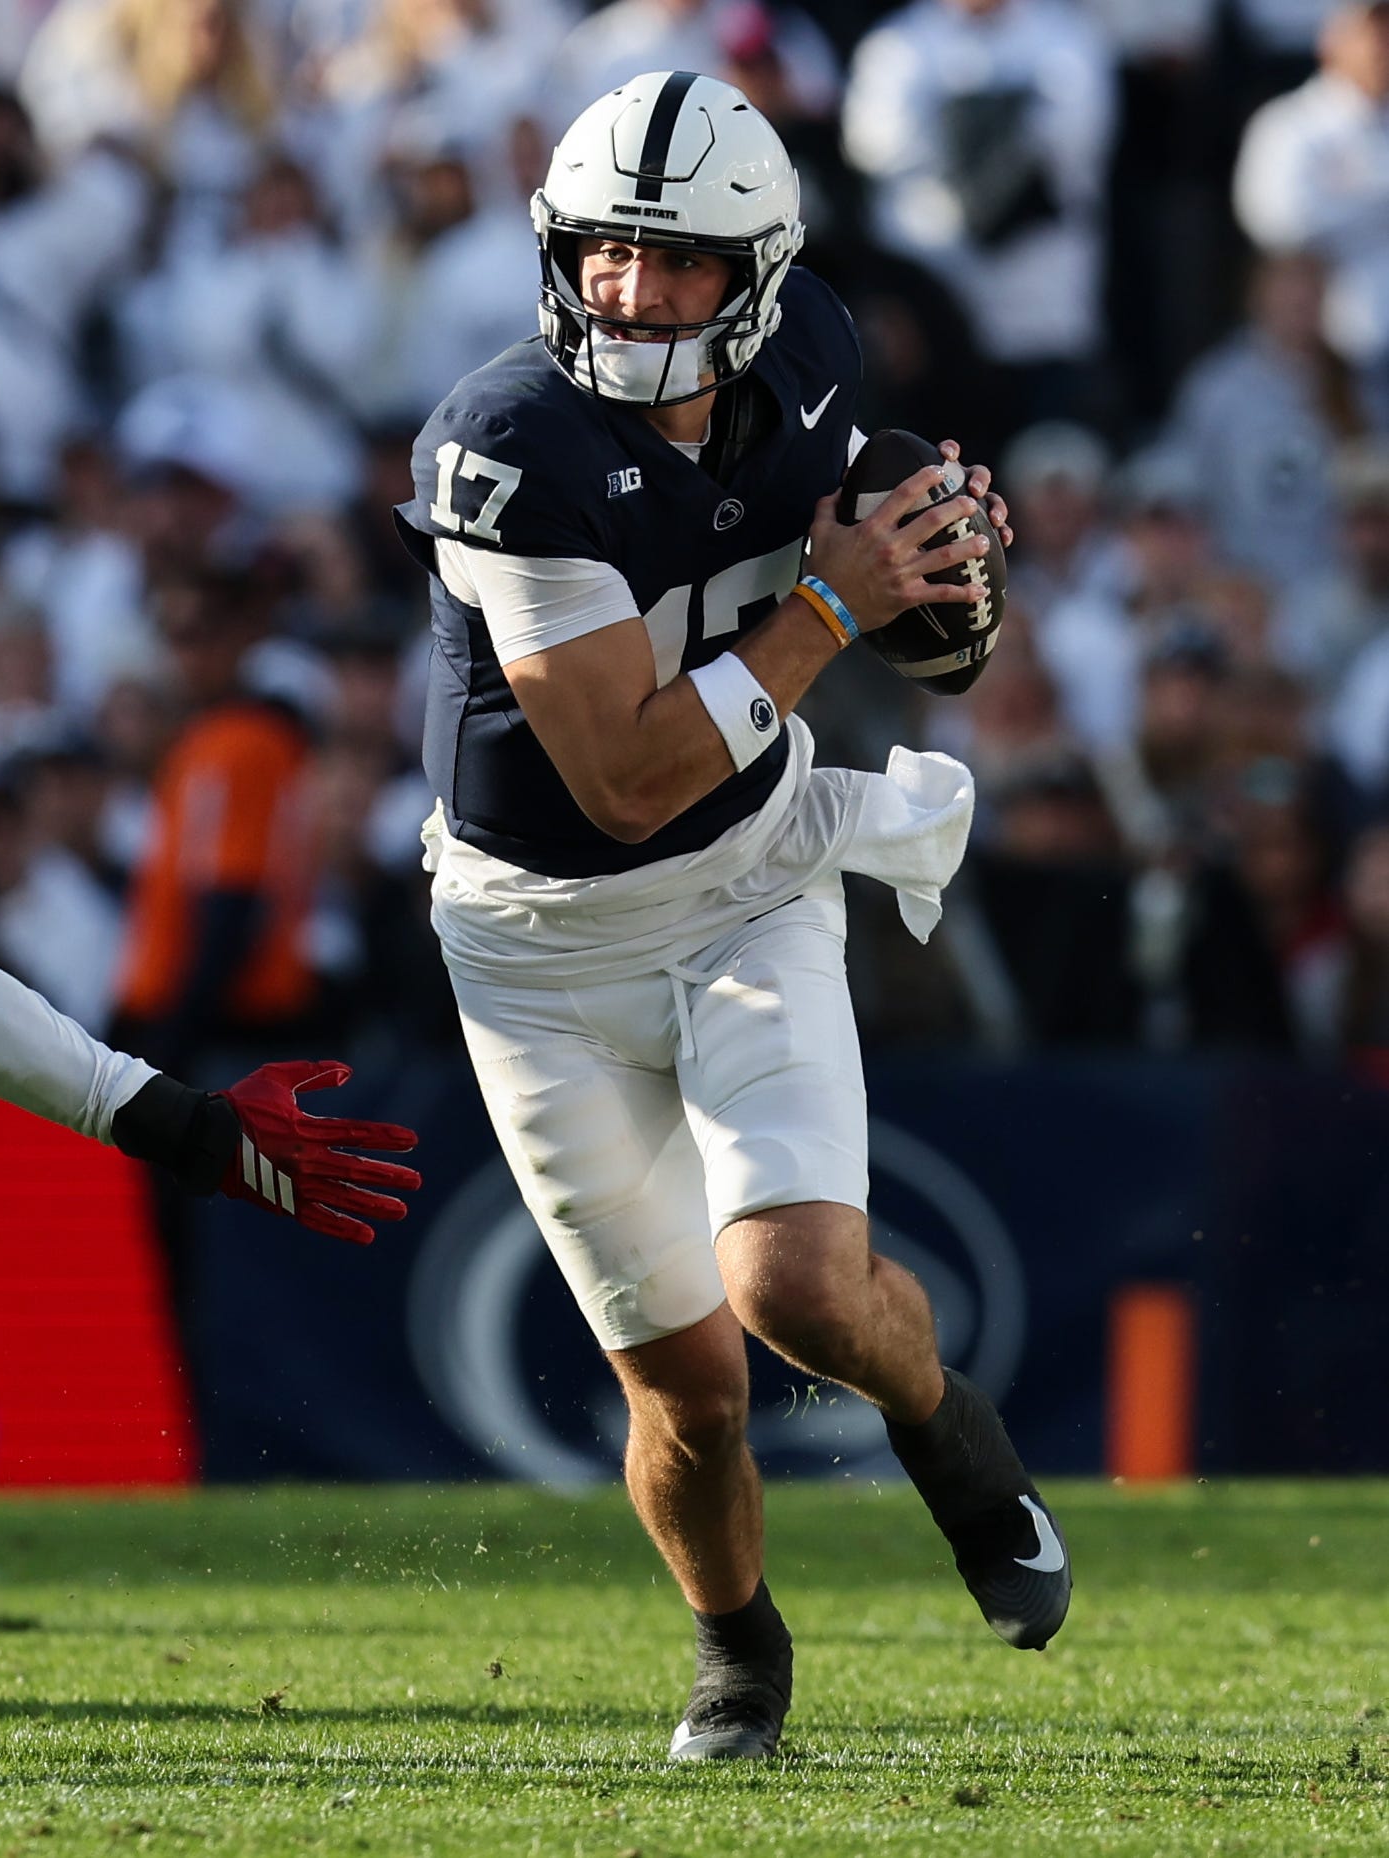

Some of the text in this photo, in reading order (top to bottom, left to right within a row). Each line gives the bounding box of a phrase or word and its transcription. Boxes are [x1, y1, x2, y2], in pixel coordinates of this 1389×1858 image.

[611, 204, 679, 220] PENN STATE
[430, 440, 523, 543] 17
